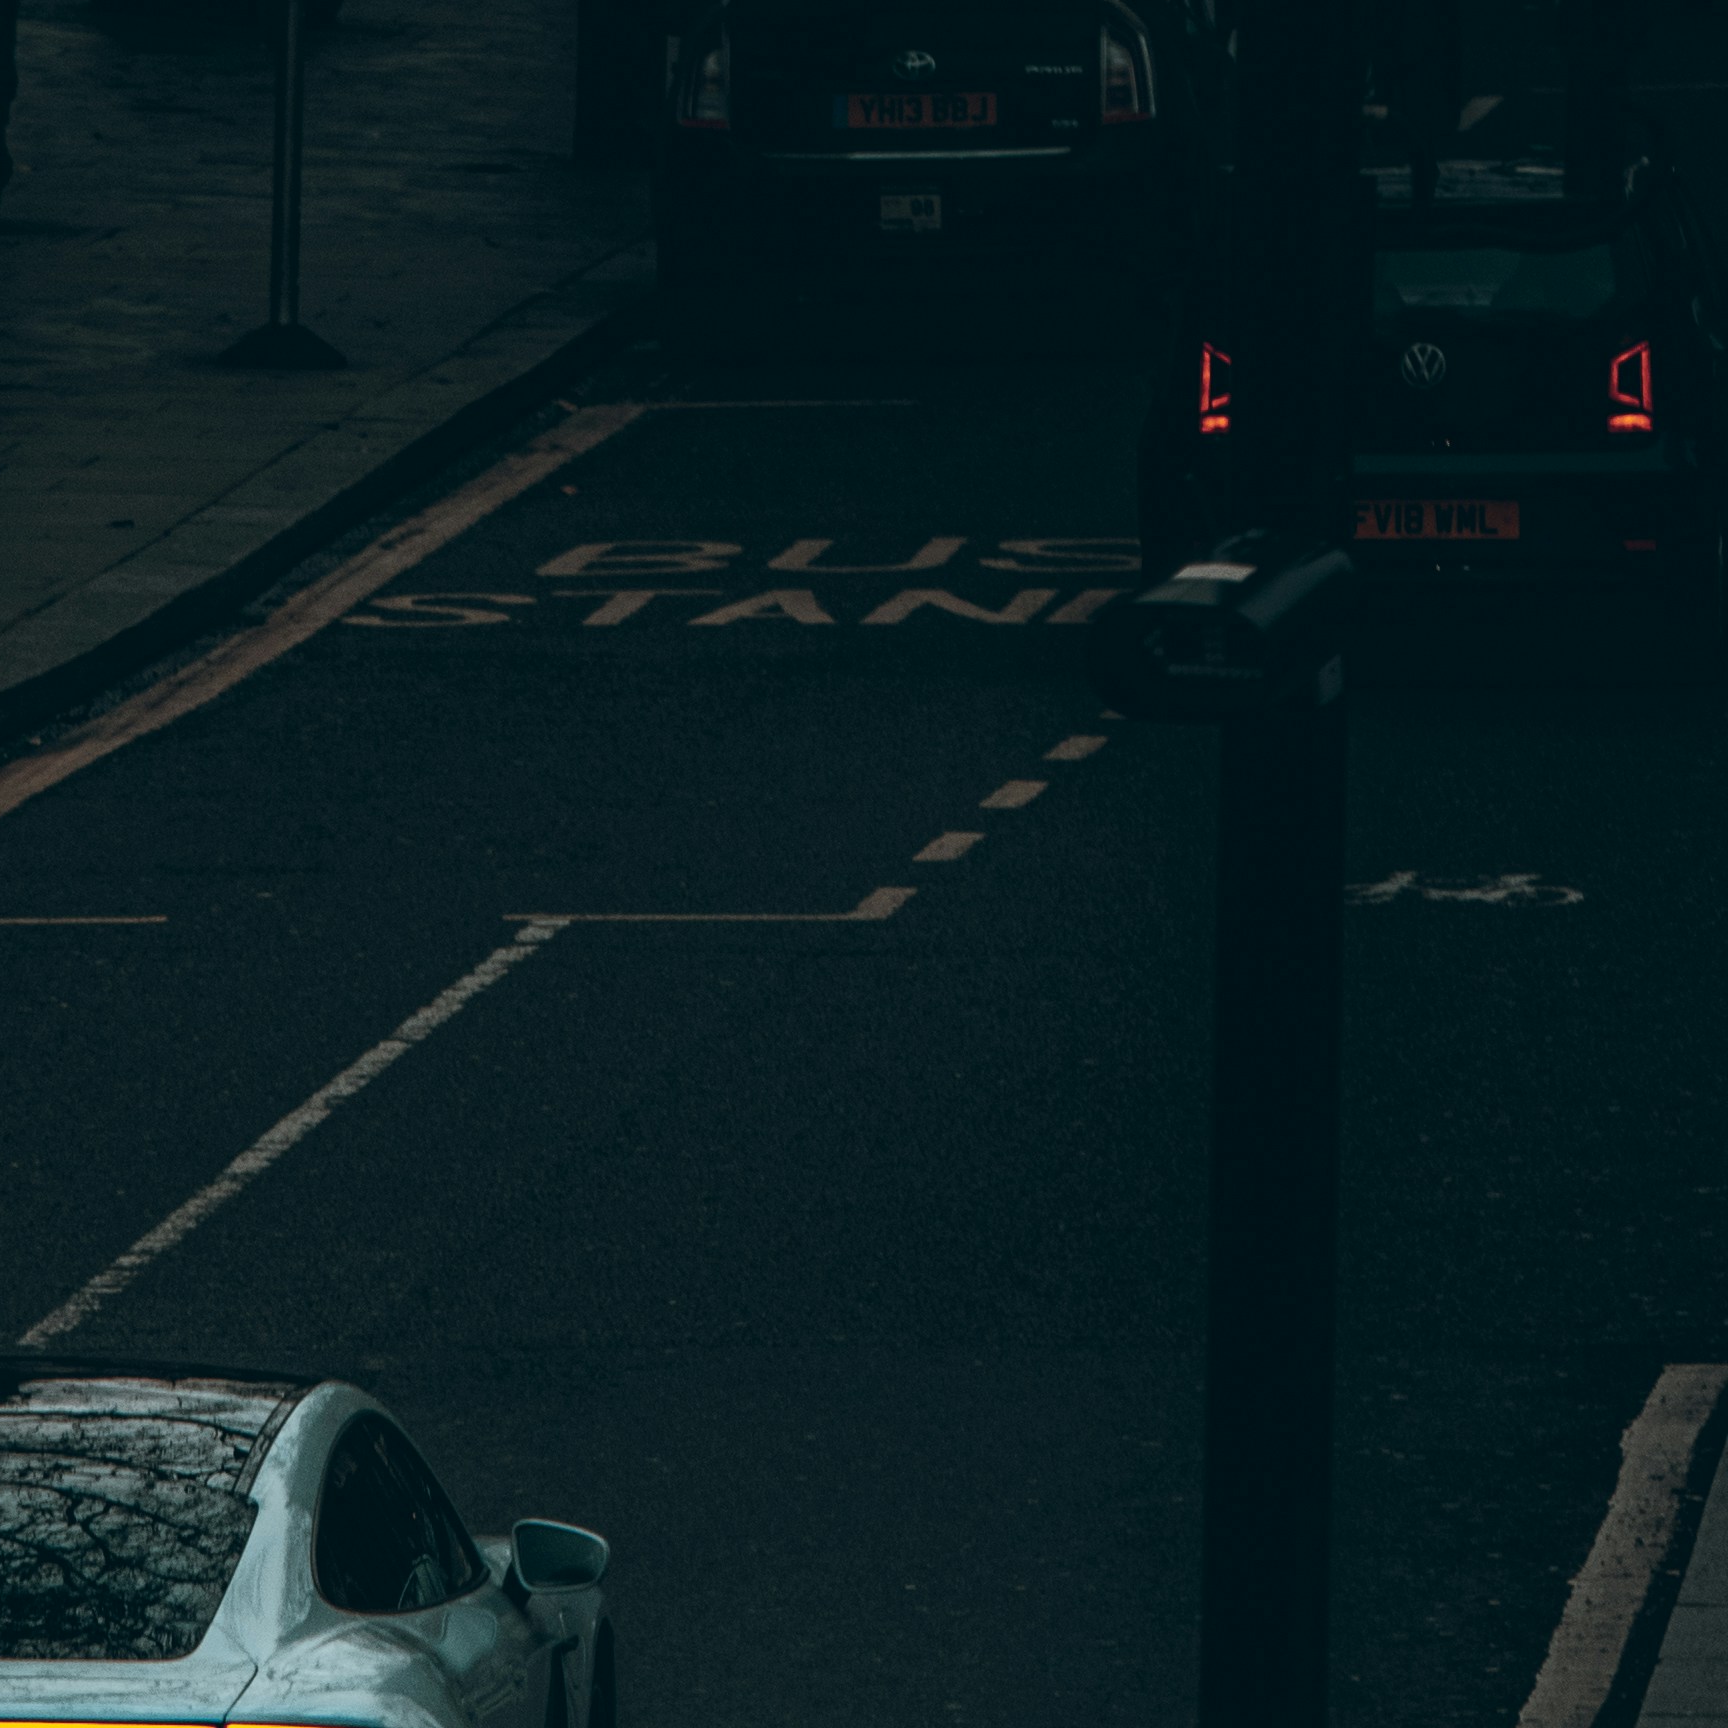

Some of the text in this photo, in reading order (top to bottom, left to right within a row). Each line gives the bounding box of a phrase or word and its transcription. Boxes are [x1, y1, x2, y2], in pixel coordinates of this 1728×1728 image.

[859, 96, 923, 123] YH13
[1434, 504, 1498, 535] WML
[534, 535, 1143, 578] BUS
